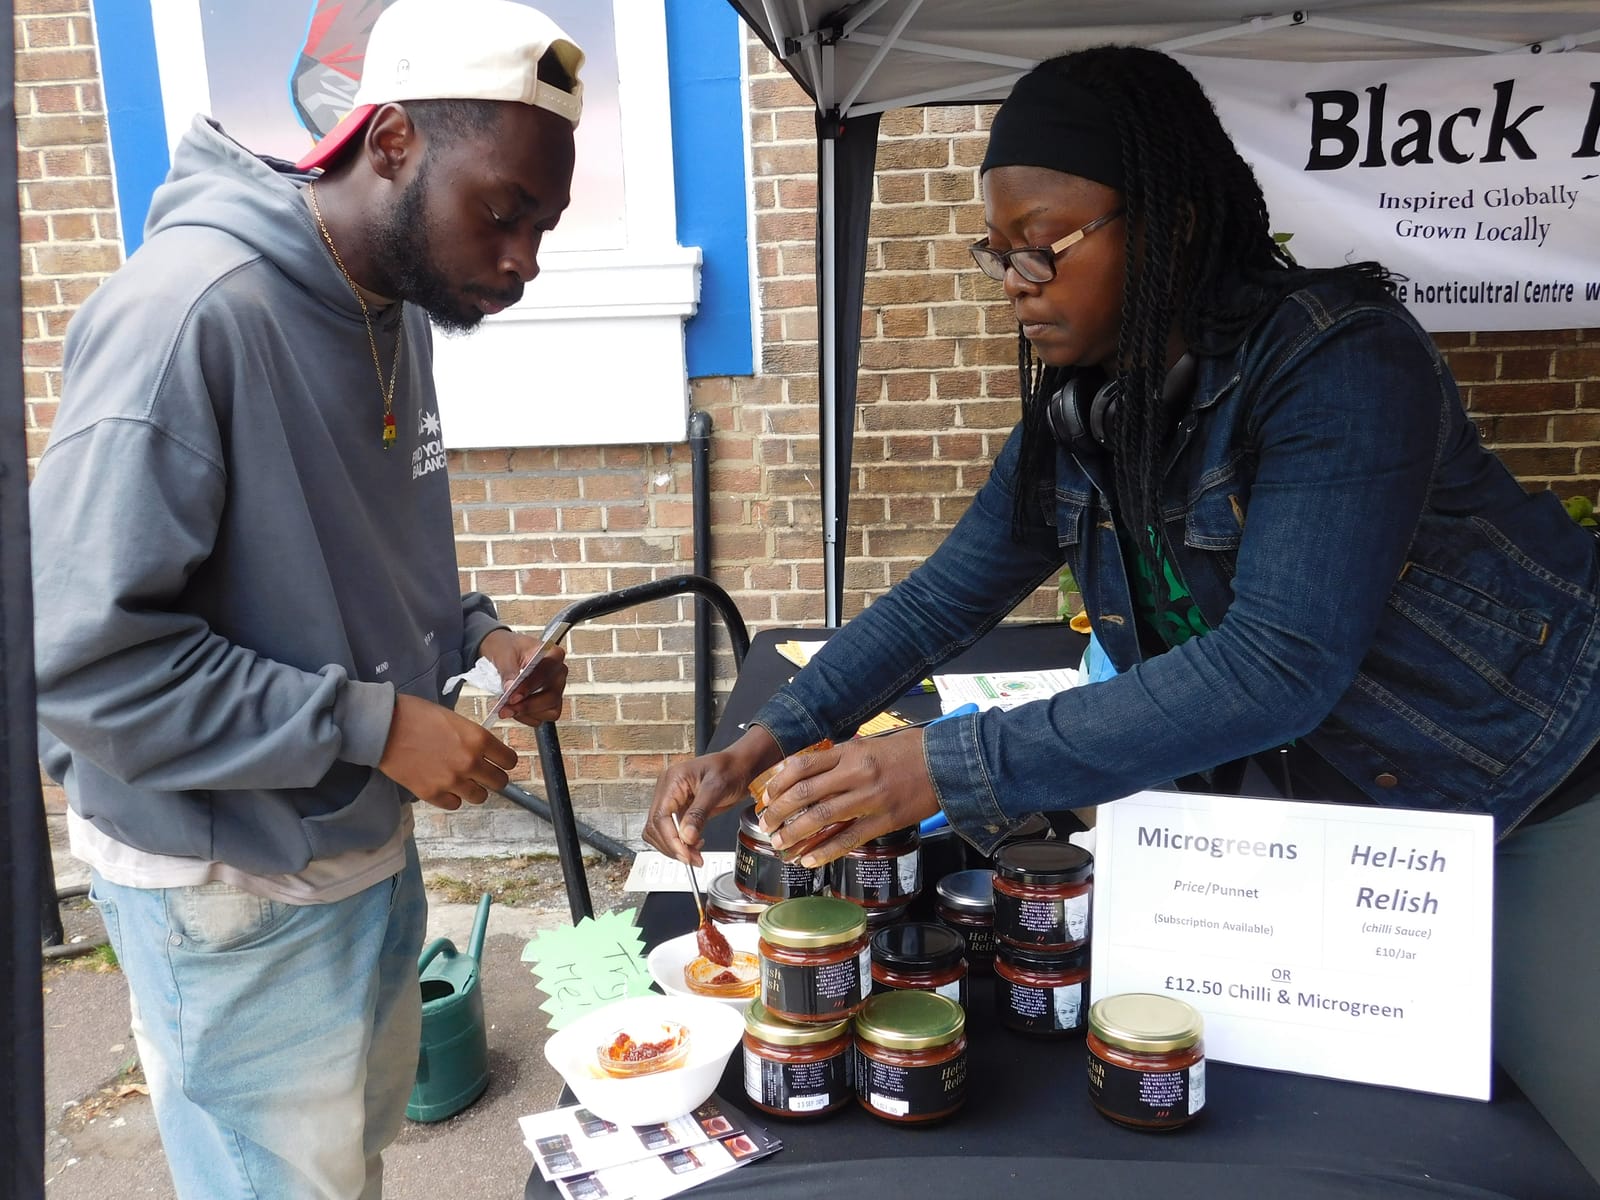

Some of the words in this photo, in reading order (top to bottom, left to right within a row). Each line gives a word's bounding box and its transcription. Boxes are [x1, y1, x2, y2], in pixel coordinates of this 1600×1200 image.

[1304, 79, 1545, 172] Black
[1378, 189, 1475, 213] Inspired
[1484, 185, 1579, 209] Globally
[1396, 219, 1467, 240] Grown
[1474, 215, 1551, 247] Locally
[1523, 280, 1575, 303] Centre
[422, 439, 446, 458] YOU
[1138, 826, 1298, 860] Microgreens
[1351, 844, 1447, 873] Hel-ish
[1173, 880, 1260, 899] Price/Punnet
[1356, 887, 1439, 915] Relish
[1153, 913, 1220, 929] (Subscription
[1222, 921, 1274, 936] Available)
[1361, 921, 1393, 935] (chilli
[1394, 926, 1432, 940] Sauce)
[1376, 947, 1417, 960] £10/Jar
[1271, 968, 1292, 982] OR
[1164, 976, 1223, 996] £12.50
[1228, 984, 1271, 1003] Chilli
[1277, 989, 1291, 1005] &
[1297, 992, 1404, 1019] Microgreen
